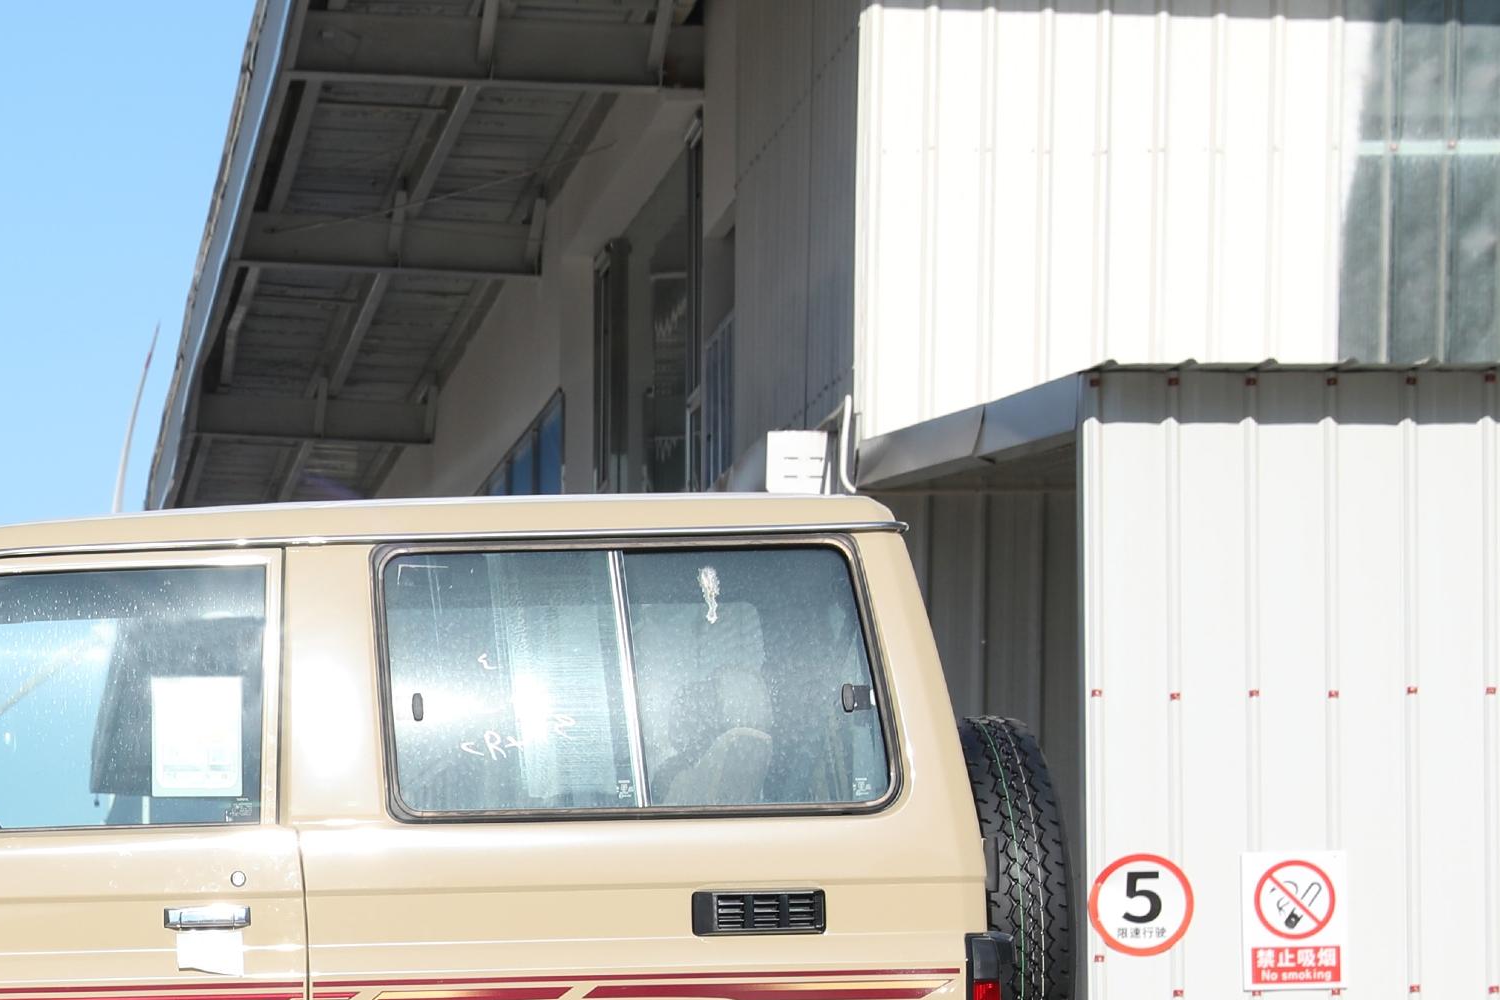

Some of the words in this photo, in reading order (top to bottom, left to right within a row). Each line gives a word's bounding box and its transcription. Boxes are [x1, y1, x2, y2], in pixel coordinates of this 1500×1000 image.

[1121, 871, 1163, 924] 5
[1257, 948, 1336, 968] 禁止吸烟
[1261, 969, 1278, 981] No
[1282, 968, 1332, 982] smoking
